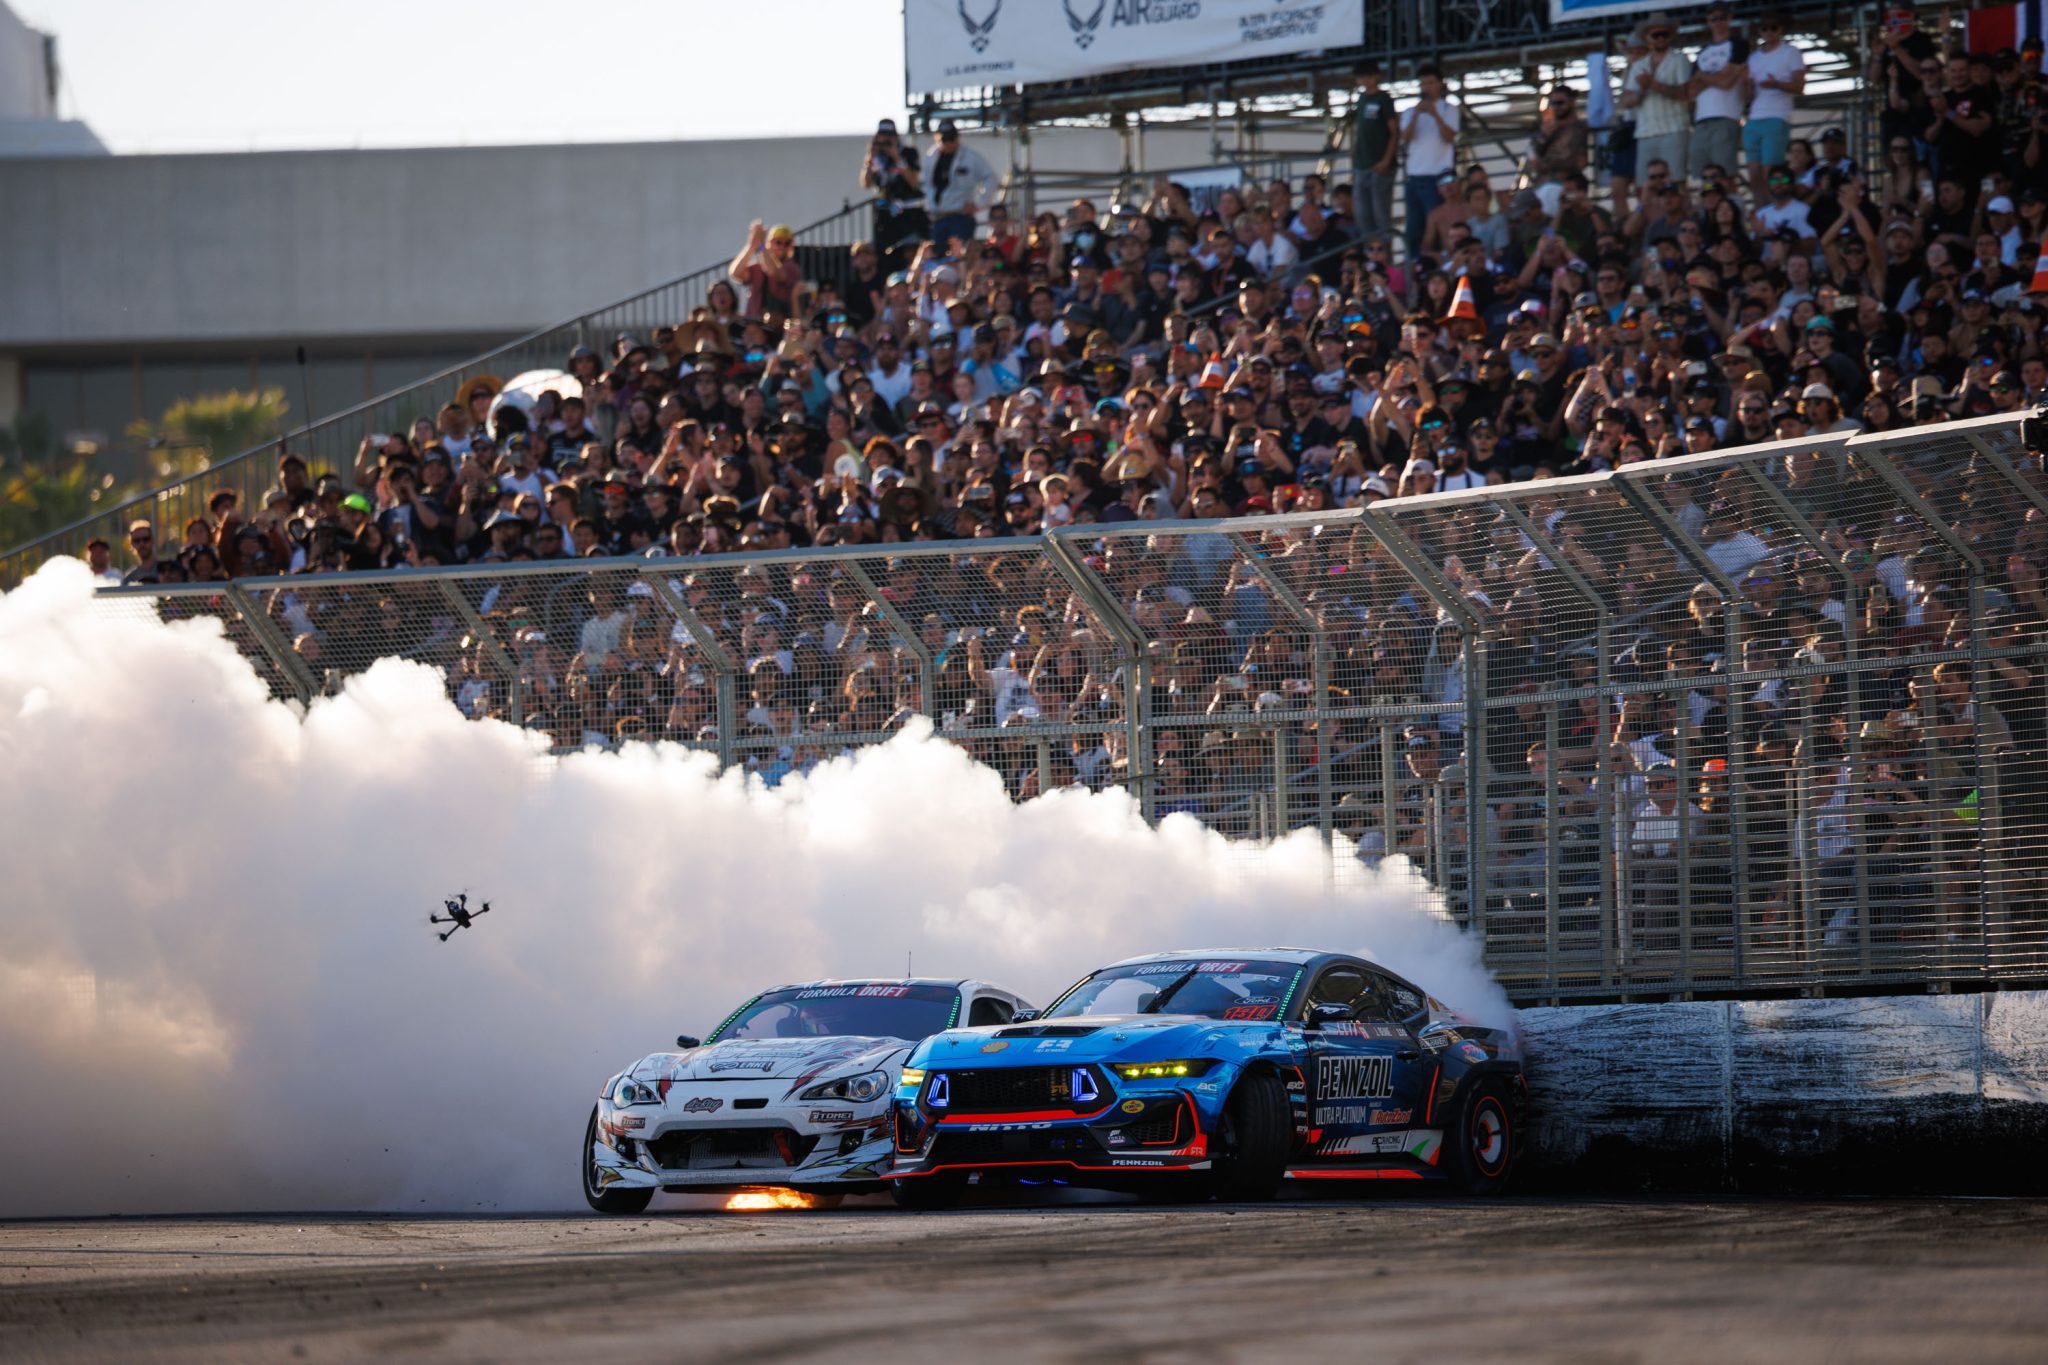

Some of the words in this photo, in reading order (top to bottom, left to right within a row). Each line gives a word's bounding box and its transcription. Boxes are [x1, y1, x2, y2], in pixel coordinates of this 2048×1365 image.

[1111, 0, 1149, 28] AIR
[1151, 2, 1200, 23] GUARD
[1271, 5, 1325, 25] FORCE
[1242, 21, 1319, 41] RESERVE
[1134, 963, 1197, 975] FORMULA
[1198, 962, 1246, 972] DRIFT
[796, 987, 856, 999] FORMULA
[858, 986, 907, 997] DRIFT
[1317, 1055, 1394, 1100] PENNZOIL
[817, 1112, 852, 1120] TOMEI
[1315, 1106, 1335, 1126] ULTRA
[1335, 1105, 1367, 1124] PLATINUM
[969, 1121, 1052, 1132] NITTO
[1112, 1159, 1165, 1167] PENNZOIL
